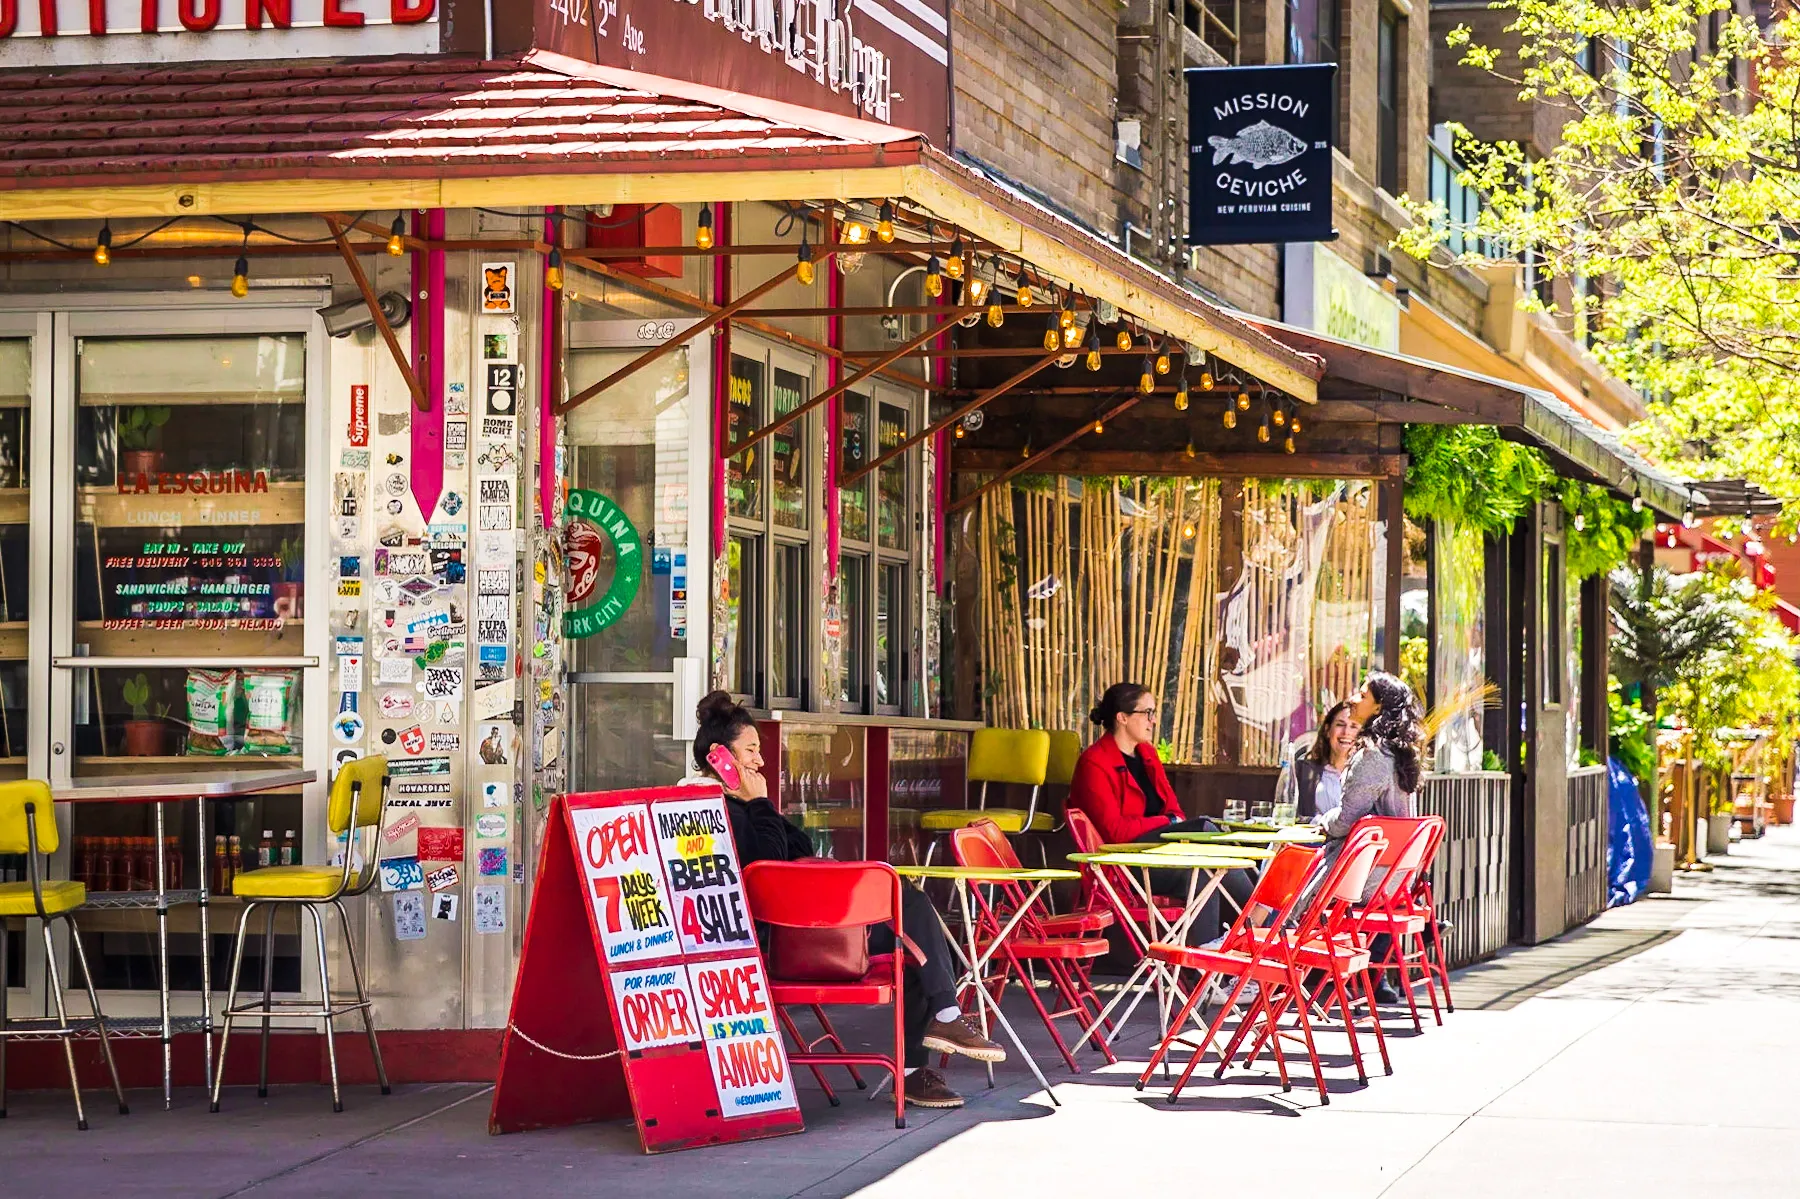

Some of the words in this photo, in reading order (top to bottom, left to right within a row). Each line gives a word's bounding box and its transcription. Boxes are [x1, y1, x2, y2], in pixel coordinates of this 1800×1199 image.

[551, 0, 588, 26] 402
[622, 13, 646, 55] Ave.
[1213, 93, 1309, 120] MISSION
[1216, 168, 1308, 197] CEVICHE
[1217, 205, 1235, 214] NEW
[1238, 204, 1277, 213] PERUVIAN
[1280, 202, 1312, 212] CUISINE
[493, 368, 511, 386] 12
[352, 387, 365, 444] Supreme
[483, 418, 513, 428] ROME
[483, 426, 513, 435] EIGHT
[117, 471, 150, 495] LA
[157, 471, 269, 495] ESQUINA
[480, 489, 509, 500] MAVEN
[127, 511, 182, 524] LUNCH
[200, 510, 261, 523] DINNER
[143, 543, 165, 555] EAT
[166, 543, 181, 554] IN
[192, 543, 219, 554] TAKE
[222, 542, 246, 554] OUT
[431, 541, 463, 549] WELCOME
[105, 557, 133, 568] FREE
[136, 557, 190, 568] DELIVERY
[480, 571, 509, 581] MAVEN
[115, 584, 188, 595] SANDWICHES
[200, 583, 271, 595] HAMBURGER
[147, 602, 185, 613] SOUPS
[196, 602, 240, 613] SALADS
[594, 596, 624, 626] CITY
[102, 620, 144, 631] COFFEE
[155, 619, 185, 630] BEER
[195, 619, 227, 630] SODA
[478, 629, 507, 640] MAVEN
[399, 784, 450, 793] HOWARDIAN
[657, 808, 726, 840] MARGARITAS
[586, 810, 649, 869] OPEN
[685, 836, 705, 854] AND
[667, 853, 738, 892] BEER
[592, 876, 622, 934] 7
[620, 872, 657, 900] DAYS
[626, 897, 669, 932] WEEK
[681, 896, 704, 945] 4
[696, 891, 751, 944] SALE
[610, 941, 635, 957] LUNCH
[636, 940, 643, 951] &
[644, 930, 674, 947] DINNER
[624, 976, 642, 990] POR
[644, 971, 677, 988] FAVOR!
[698, 964, 767, 1018] SPACE
[622, 988, 697, 1044] ORDER
[711, 1023, 726, 1039] IS
[730, 1018, 767, 1036] YOUR
[715, 1037, 784, 1090] AMIGO
